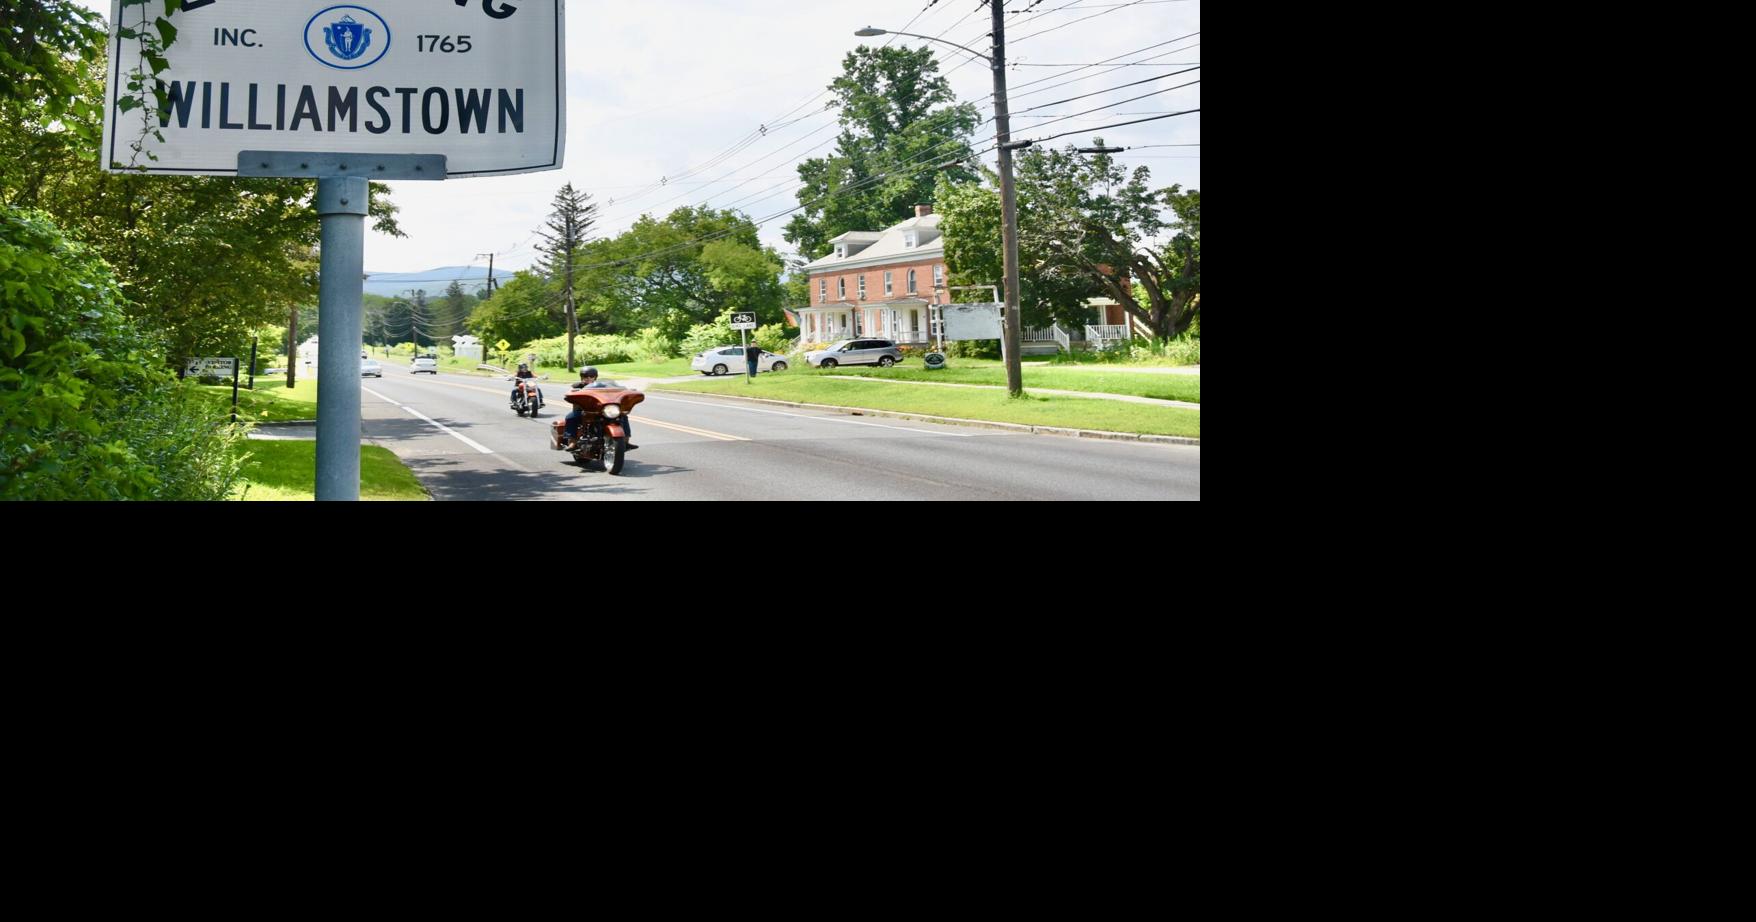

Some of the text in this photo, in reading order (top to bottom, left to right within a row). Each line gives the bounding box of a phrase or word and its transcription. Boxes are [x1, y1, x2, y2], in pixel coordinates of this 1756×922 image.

[214, 28, 472, 53] INC. 1765
[155, 80, 523, 134] WILLIAMSTOWN
